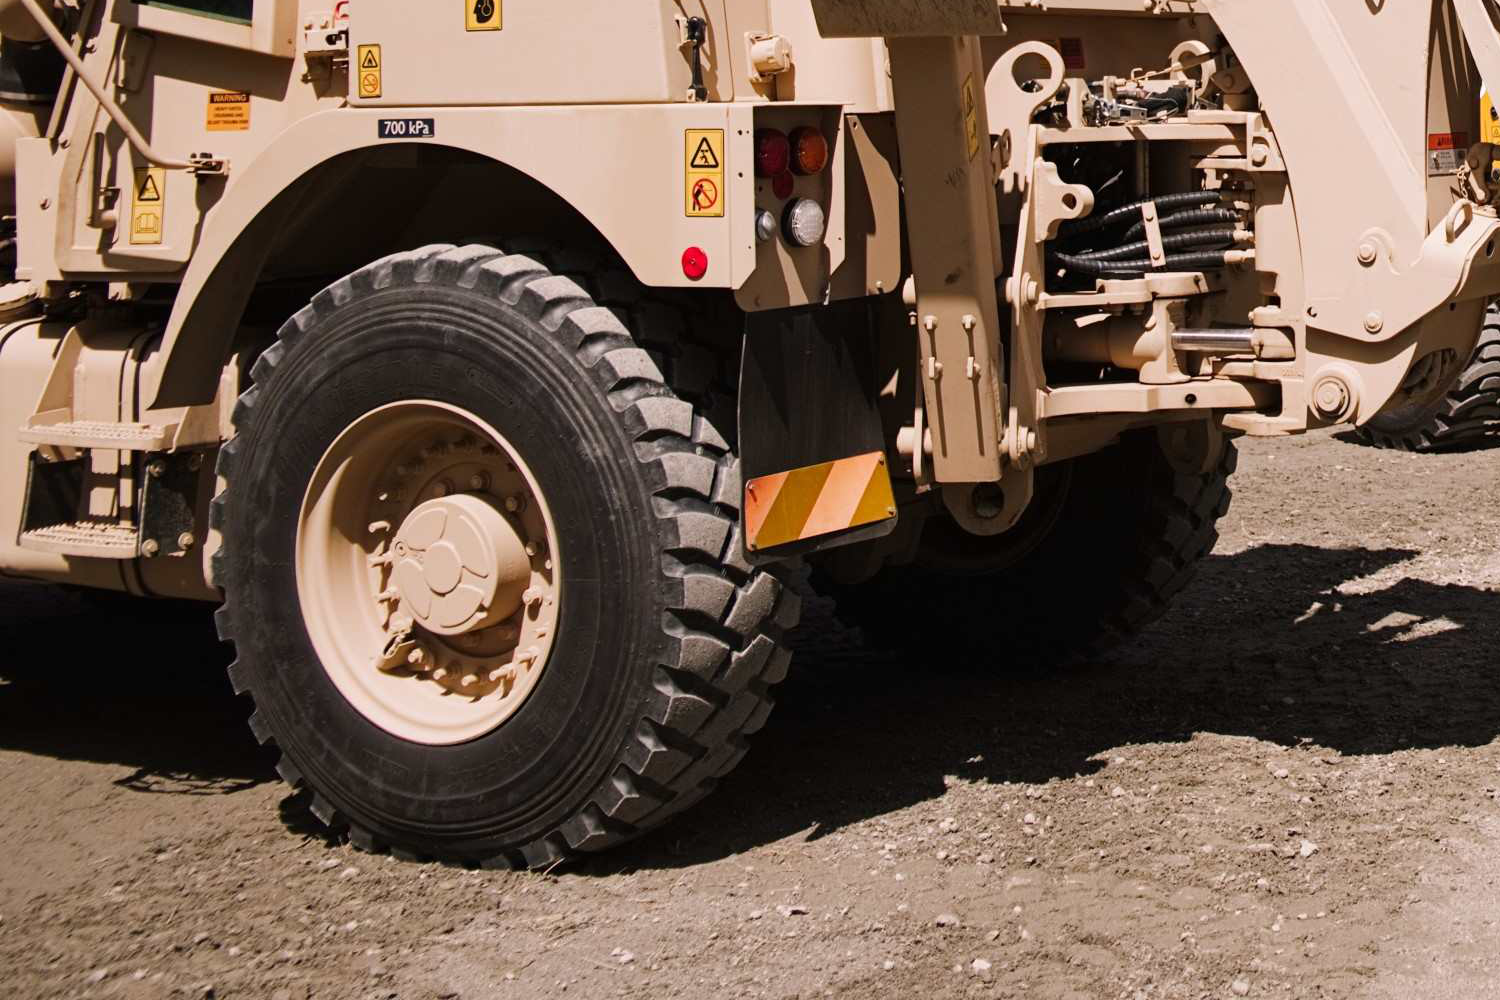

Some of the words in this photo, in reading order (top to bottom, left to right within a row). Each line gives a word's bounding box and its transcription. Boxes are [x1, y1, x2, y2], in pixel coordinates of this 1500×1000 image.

[213, 94, 247, 102] WARNING
[384, 121, 405, 135] 700
[408, 120, 430, 134] kPa
